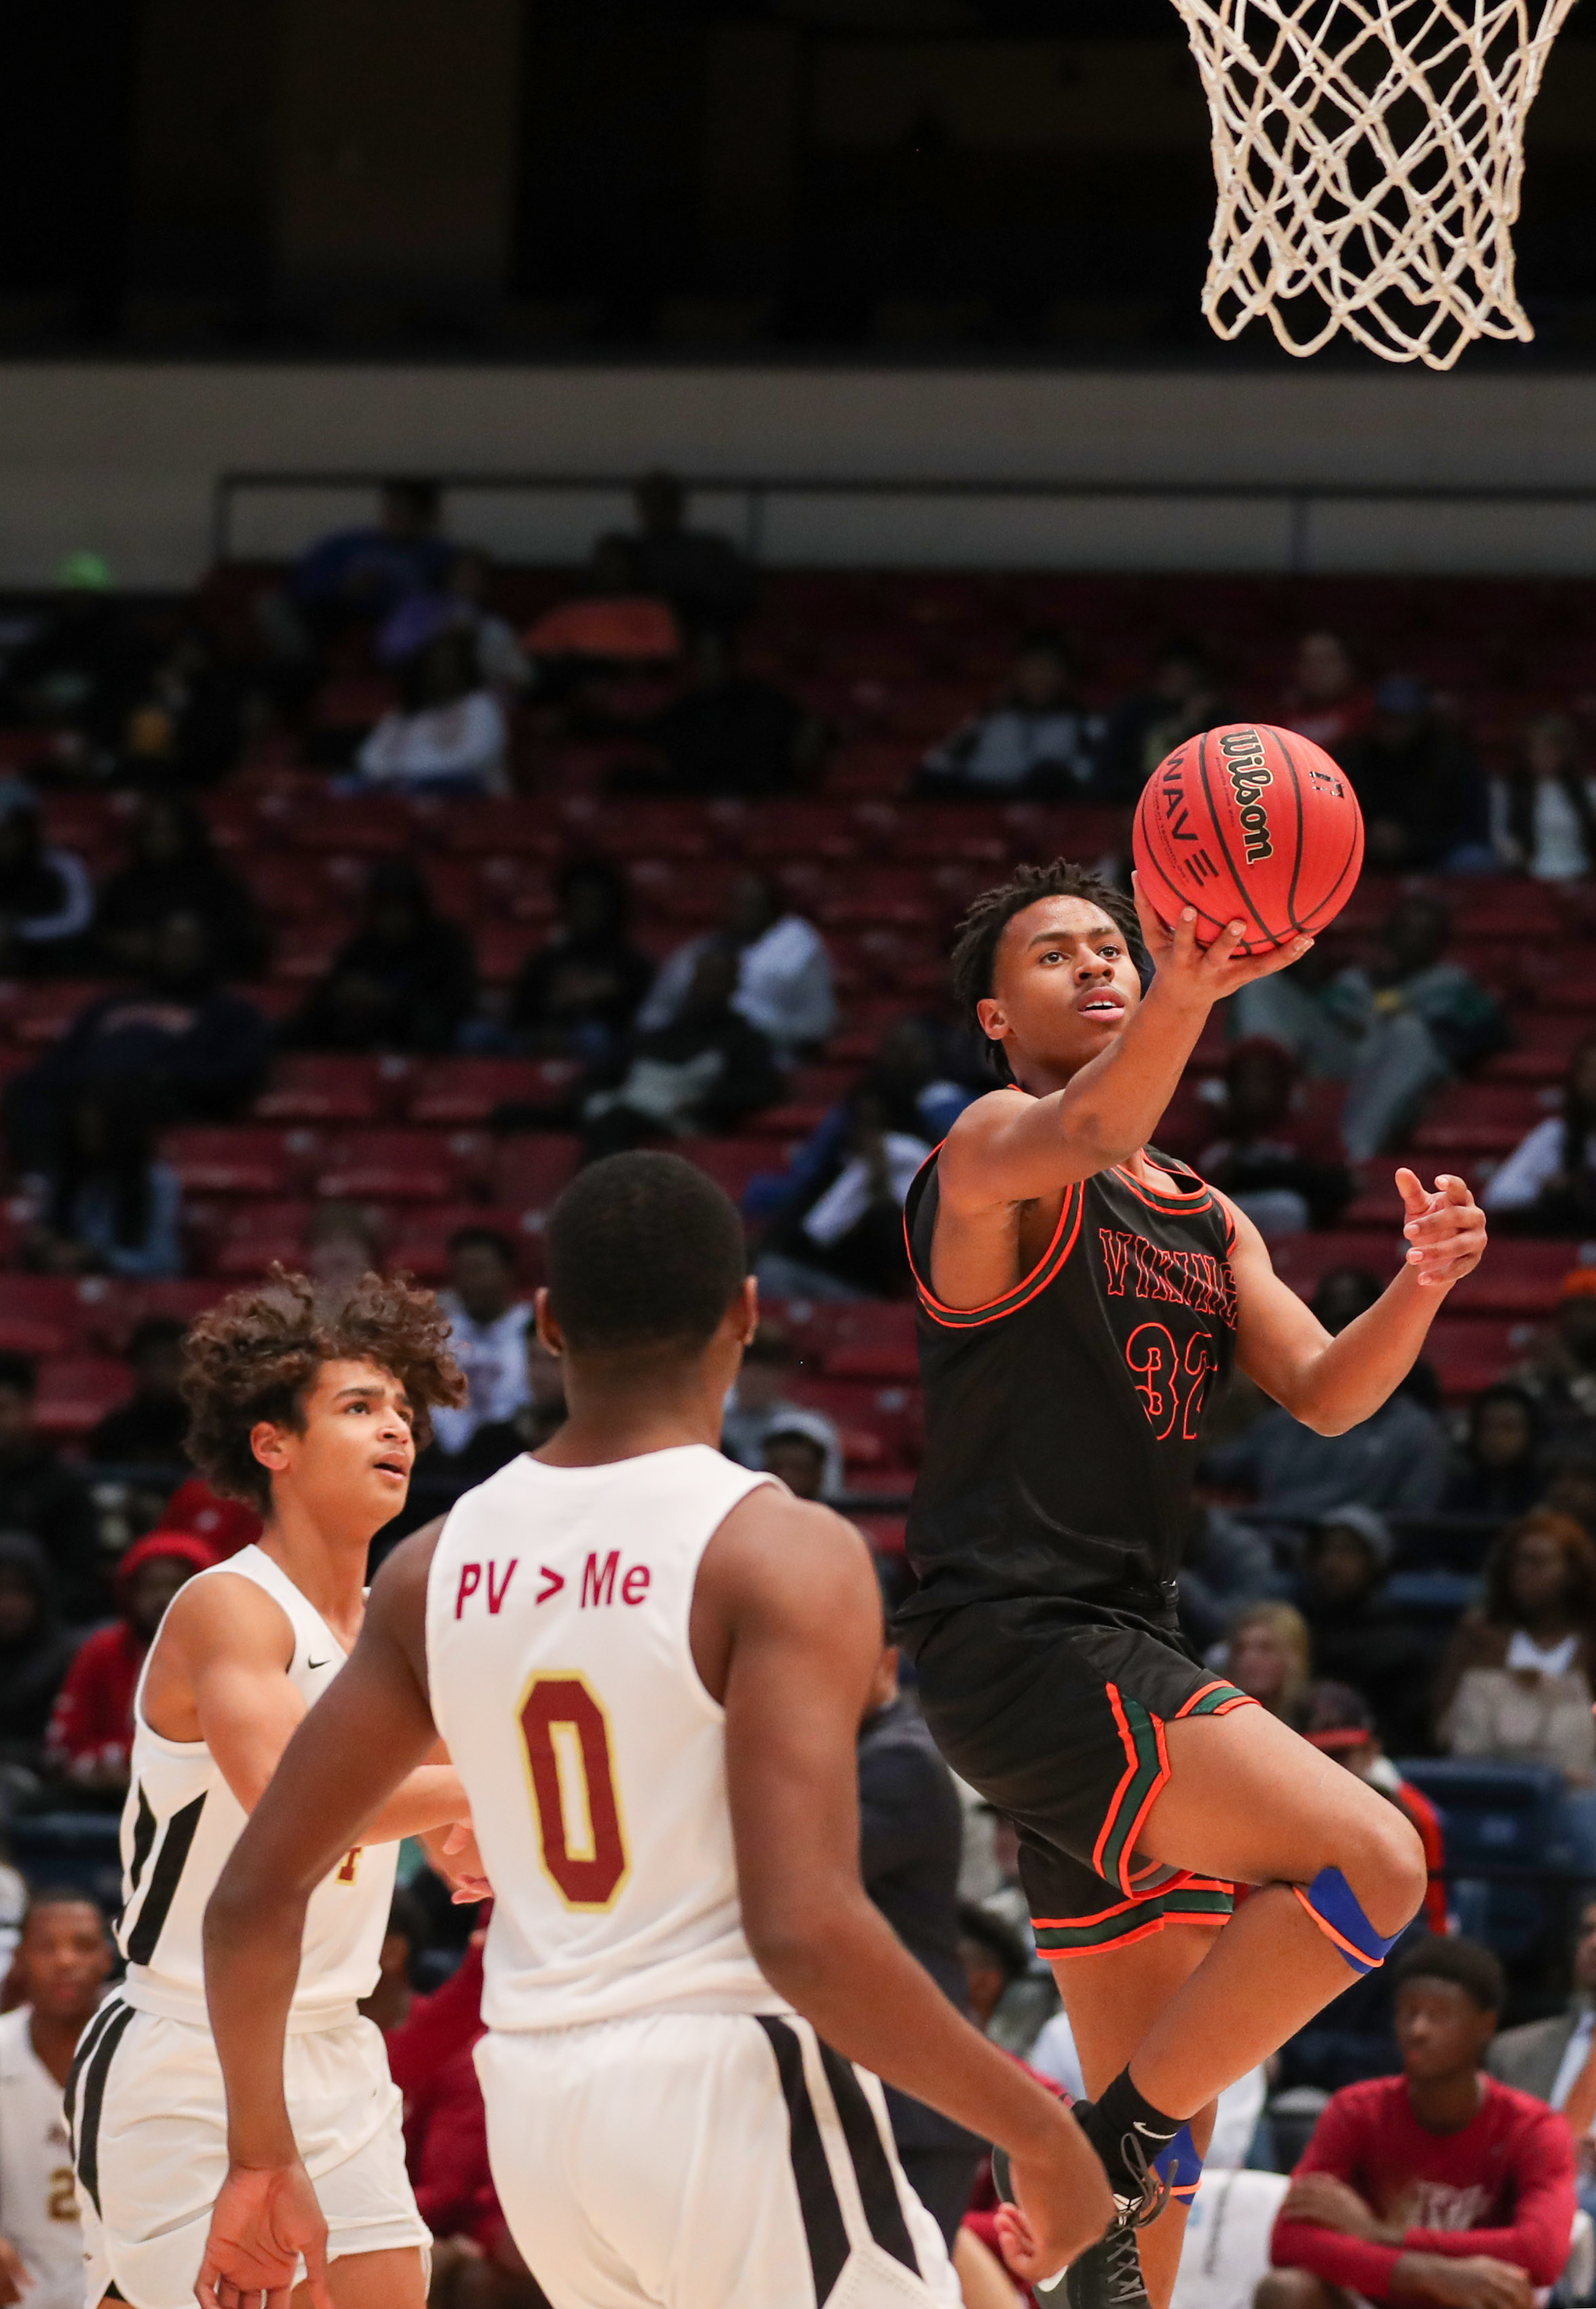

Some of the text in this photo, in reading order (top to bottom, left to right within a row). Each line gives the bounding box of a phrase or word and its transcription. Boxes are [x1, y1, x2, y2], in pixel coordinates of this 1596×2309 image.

[1163, 747, 1219, 887] WAVE
[1219, 728, 1274, 865] Wilson
[1125, 1321, 1218, 1441] 32
[456, 1558, 518, 1621] PV
[580, 1550, 651, 1610] Me
[513, 1668, 632, 1914] 0
